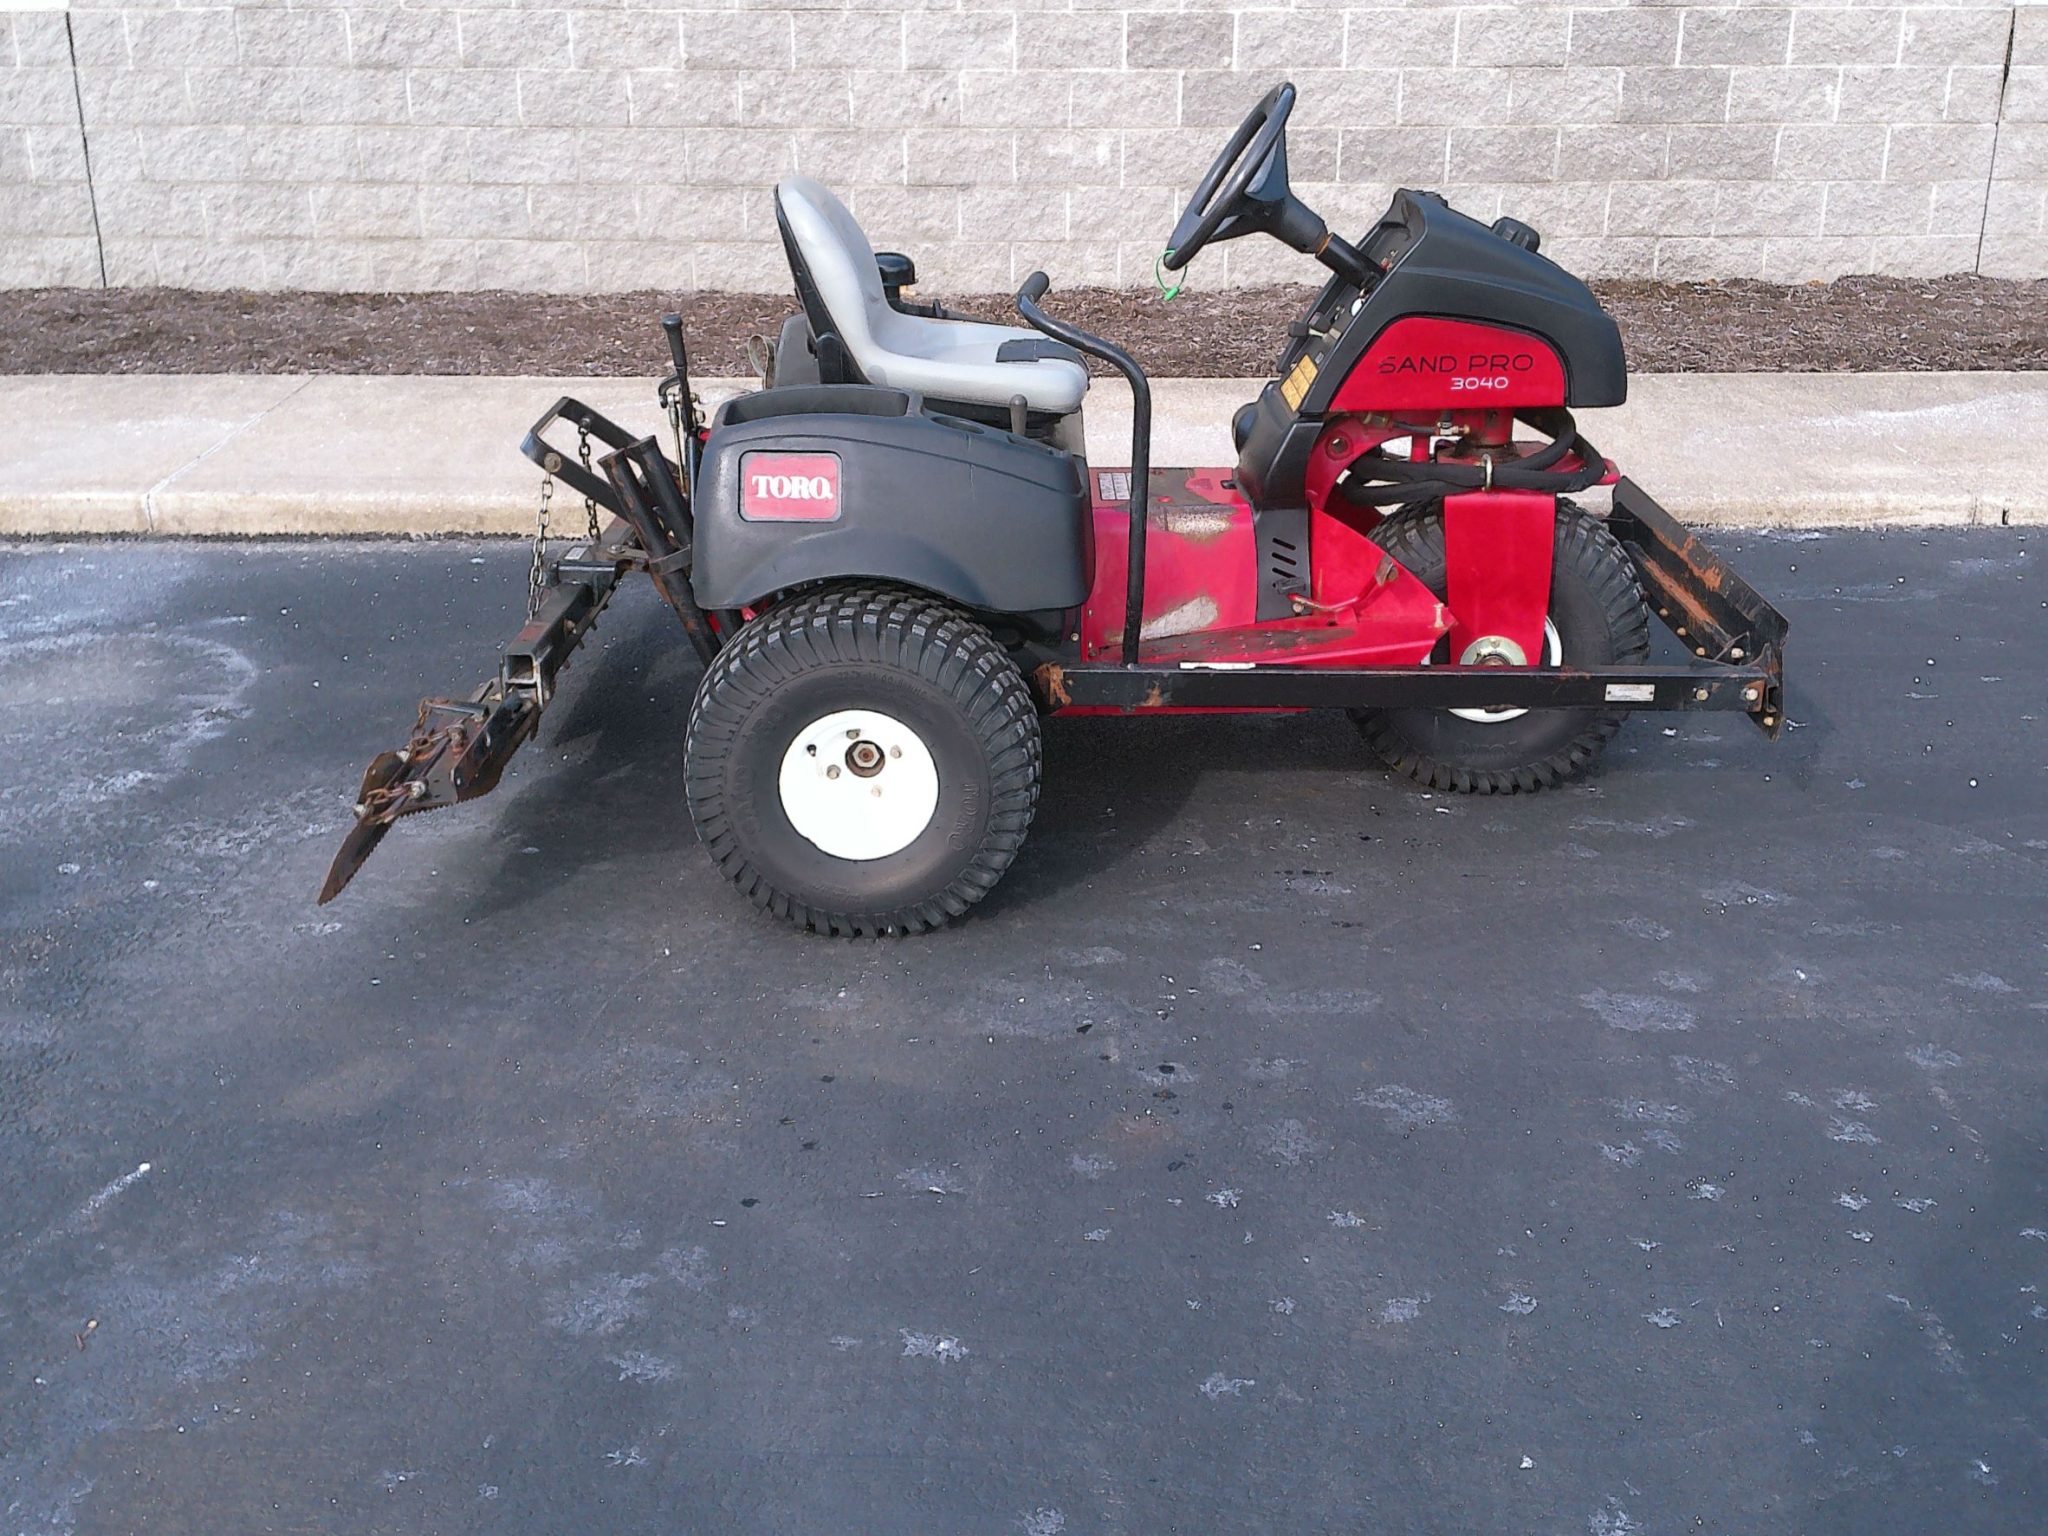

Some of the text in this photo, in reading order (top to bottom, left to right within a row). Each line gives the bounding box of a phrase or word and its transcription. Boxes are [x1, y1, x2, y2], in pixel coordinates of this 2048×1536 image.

[1379, 353, 1534, 374] SAND PRO
[1450, 376, 1509, 390] 3040
[751, 475, 834, 500] TORO
